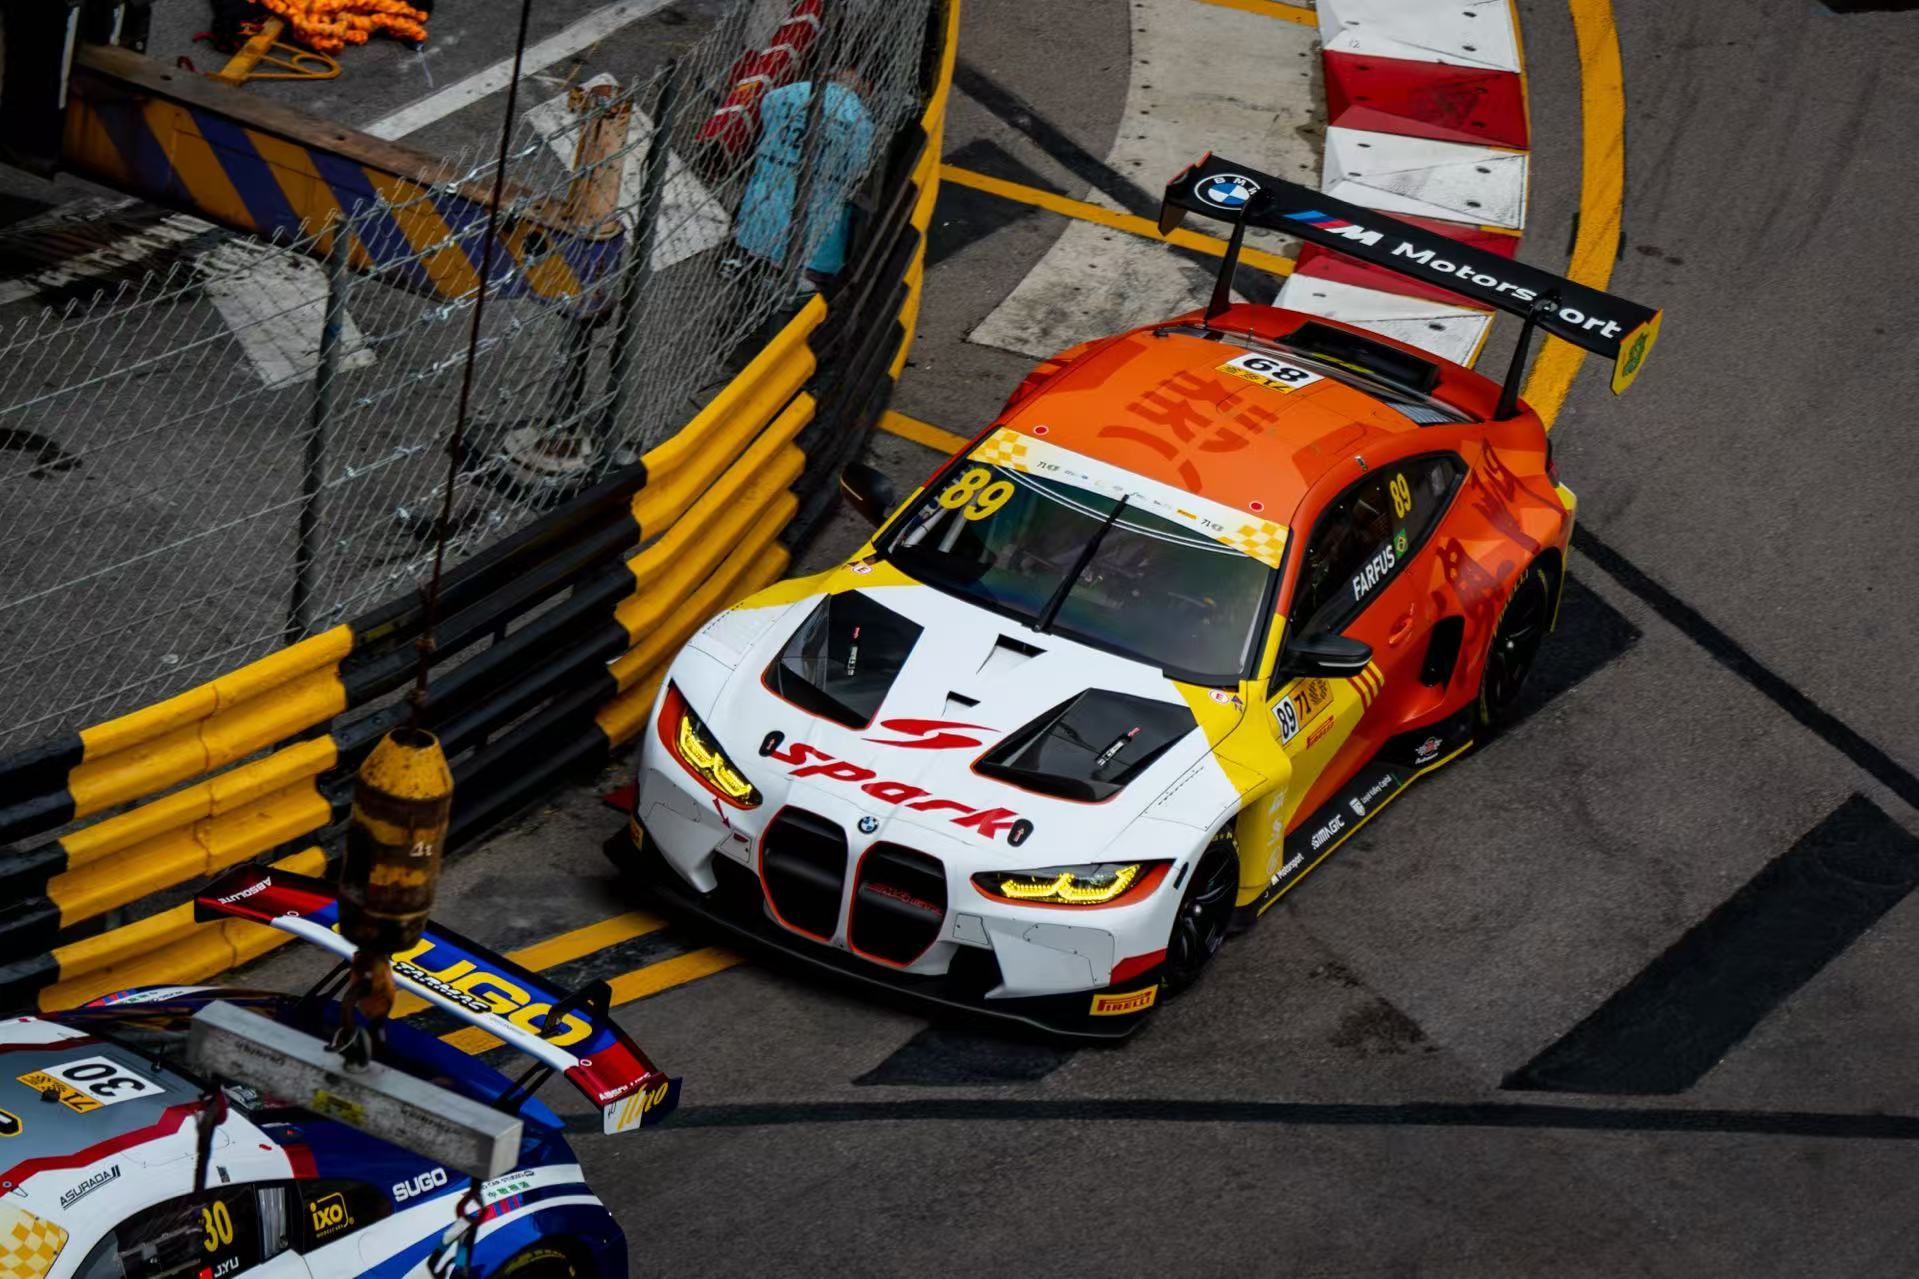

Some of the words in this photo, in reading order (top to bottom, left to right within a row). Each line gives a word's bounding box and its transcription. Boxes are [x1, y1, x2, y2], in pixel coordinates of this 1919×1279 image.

[1391, 241, 1623, 339] Motorsort
[939, 468, 1016, 521] 89
[1389, 472, 1412, 519] 89
[1352, 544, 1396, 602] FARFUS
[1276, 700, 1297, 740] 89
[1293, 690, 1312, 722] 71
[769, 742, 1019, 840] spark
[218, 875, 273, 905] ABSOLUTE
[333, 922, 593, 1047] UGO
[1096, 990, 1153, 1012] PIRELLI
[62, 1063, 146, 1098] 30
[63, 1091, 97, 1111] 71
[59, 1170, 112, 1208] ASURADA
[392, 1167, 448, 1203] SUGO
[202, 1200, 234, 1253] 30
[310, 1202, 343, 1232] ixo
